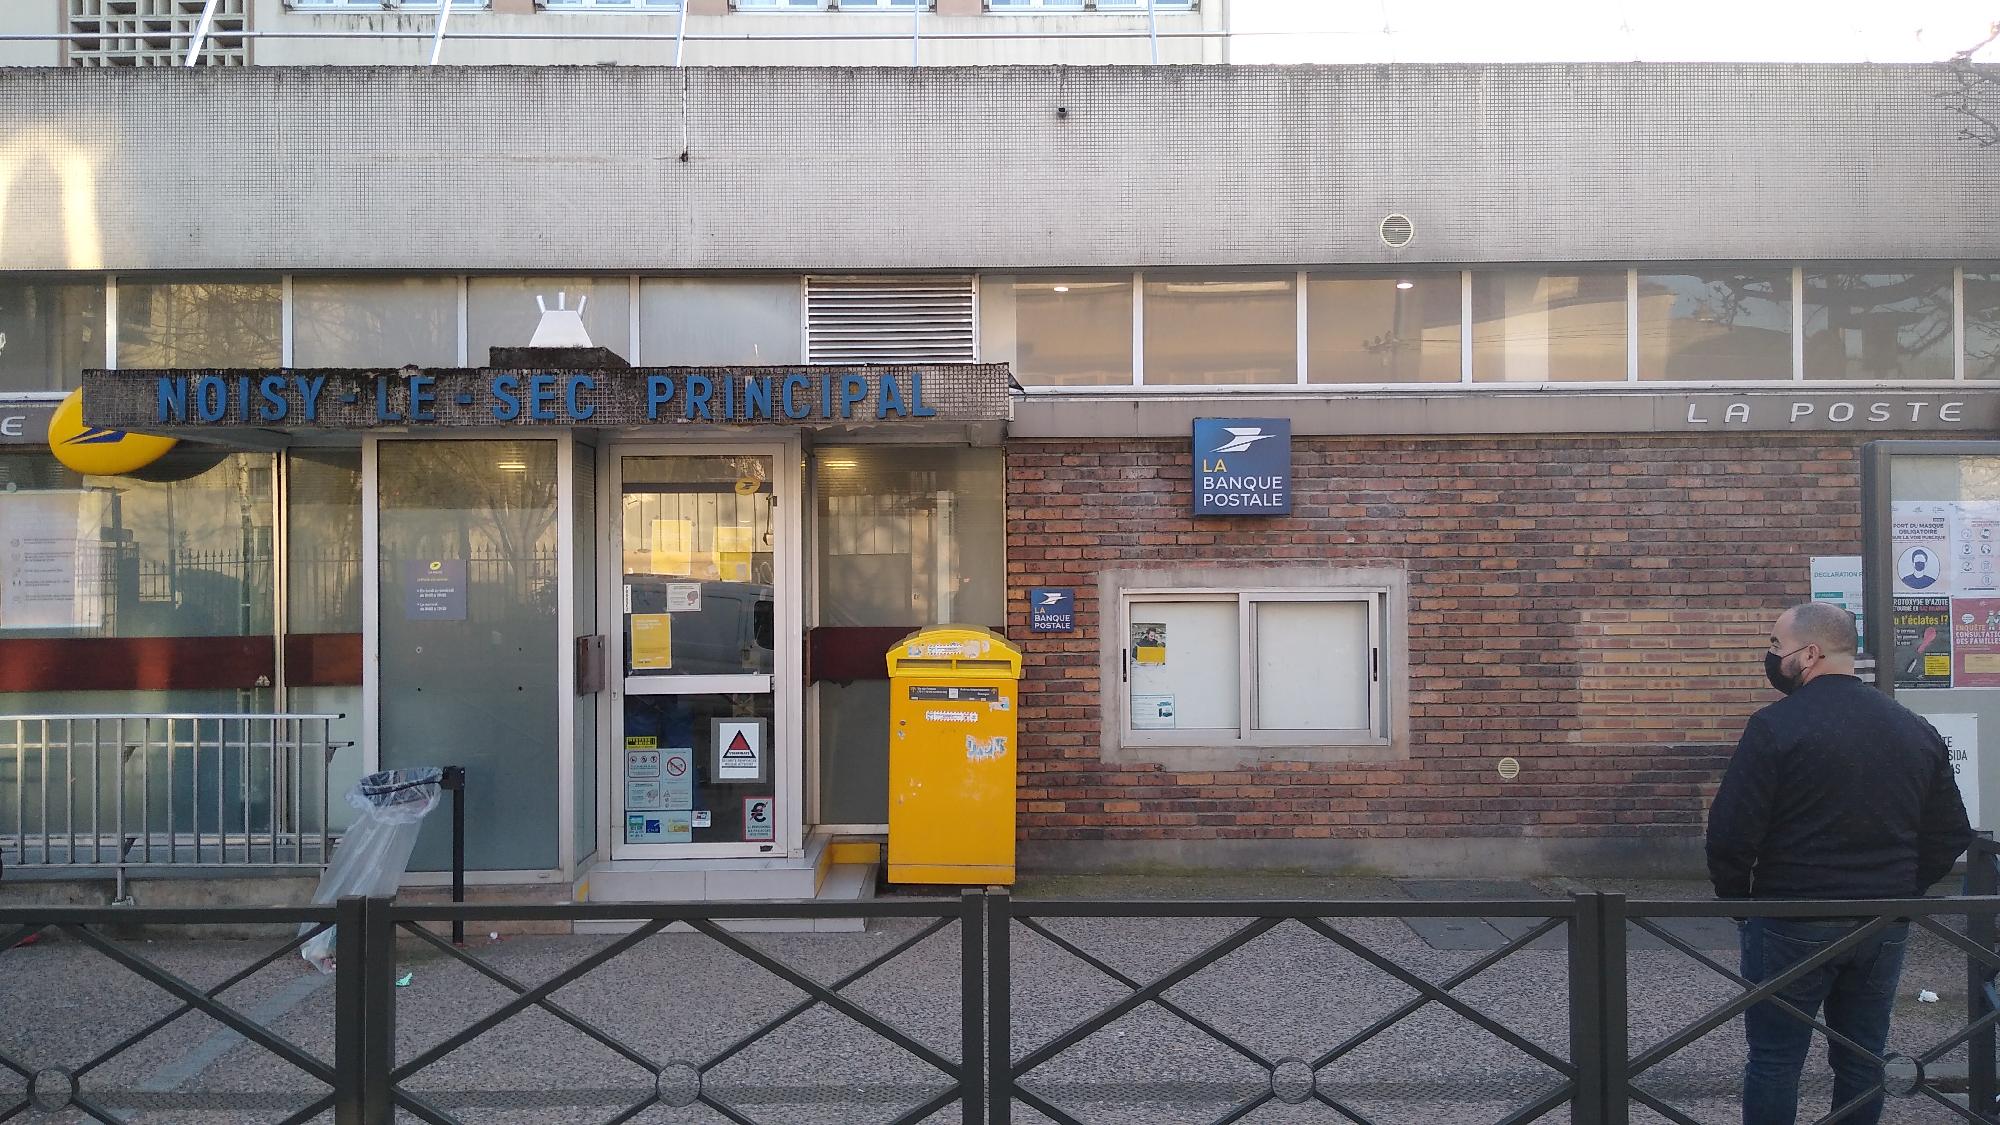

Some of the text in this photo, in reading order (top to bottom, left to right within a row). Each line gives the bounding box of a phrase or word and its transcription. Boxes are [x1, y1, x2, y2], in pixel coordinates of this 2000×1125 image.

[158, 375, 326, 422] NOISY
[377, 375, 437, 422] LE
[492, 375, 596, 421] SEC
[647, 372, 937, 420] PRINCIPAL
[1687, 402, 1964, 423] LA POSTE
[1203, 459, 1228, 473] LA
[1203, 476, 1283, 492] BANQUE
[1203, 493, 1283, 507] POSTALE
[1034, 614, 1071, 622] BANQUE
